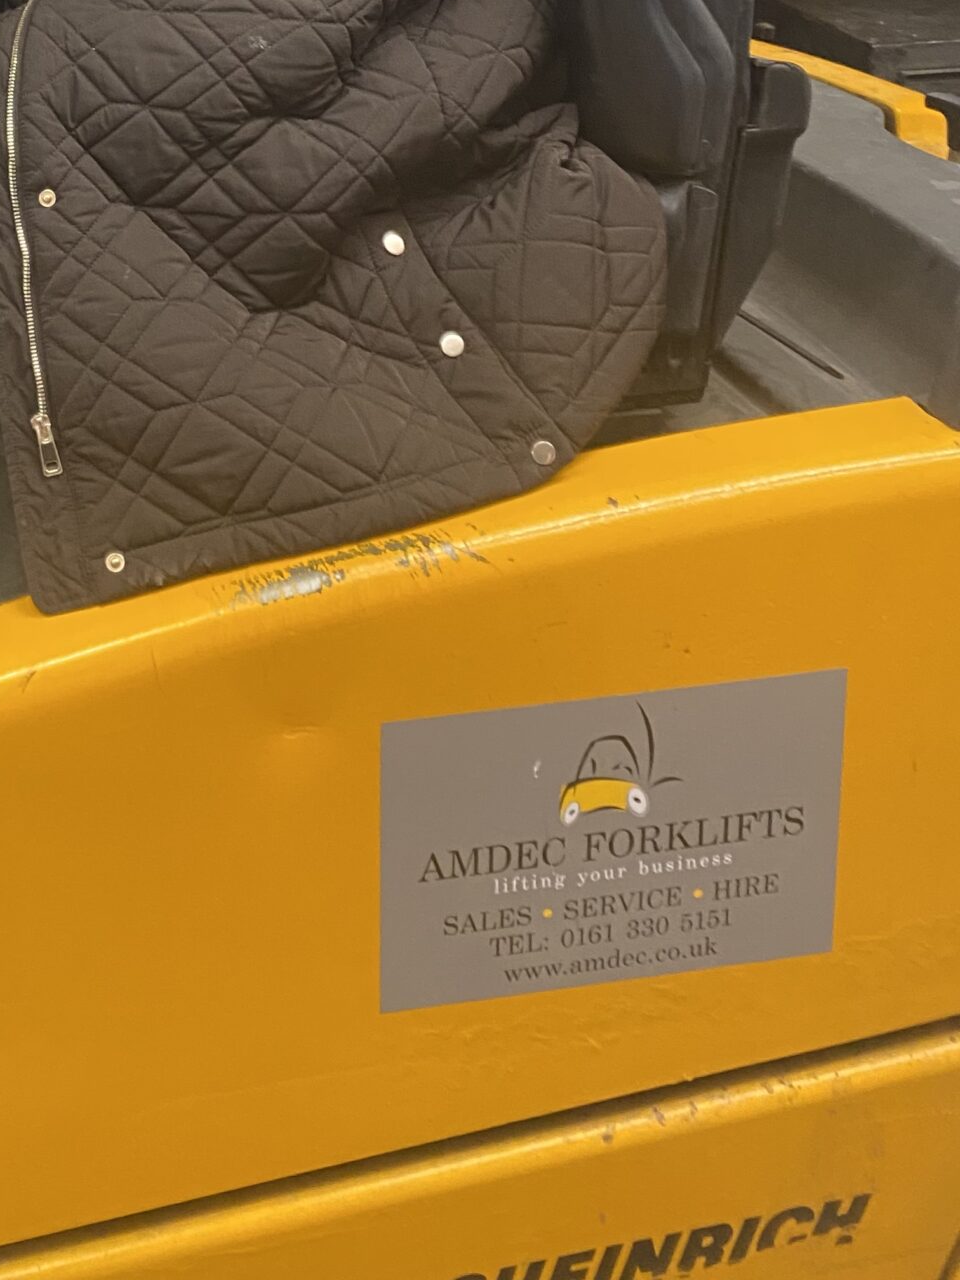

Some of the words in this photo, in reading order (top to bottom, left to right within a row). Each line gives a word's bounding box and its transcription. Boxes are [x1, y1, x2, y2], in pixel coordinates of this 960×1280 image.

[418, 837, 566, 883] AMDEC
[583, 806, 805, 862] FORKLIFTS
[494, 873, 567, 895] lifting
[577, 866, 628, 887] your
[638, 853, 734, 876] business
[443, 906, 532, 936] SALES
[563, 886, 682, 920] SERVICE
[712, 873, 780, 901] HIRE
[489, 932, 549, 957] TEL:
[560, 924, 613, 948] 0161
[626, 916, 670, 939] 330
[680, 908, 732, 933] 5151
[504, 936, 718, 982] www.amdec.co.uk
